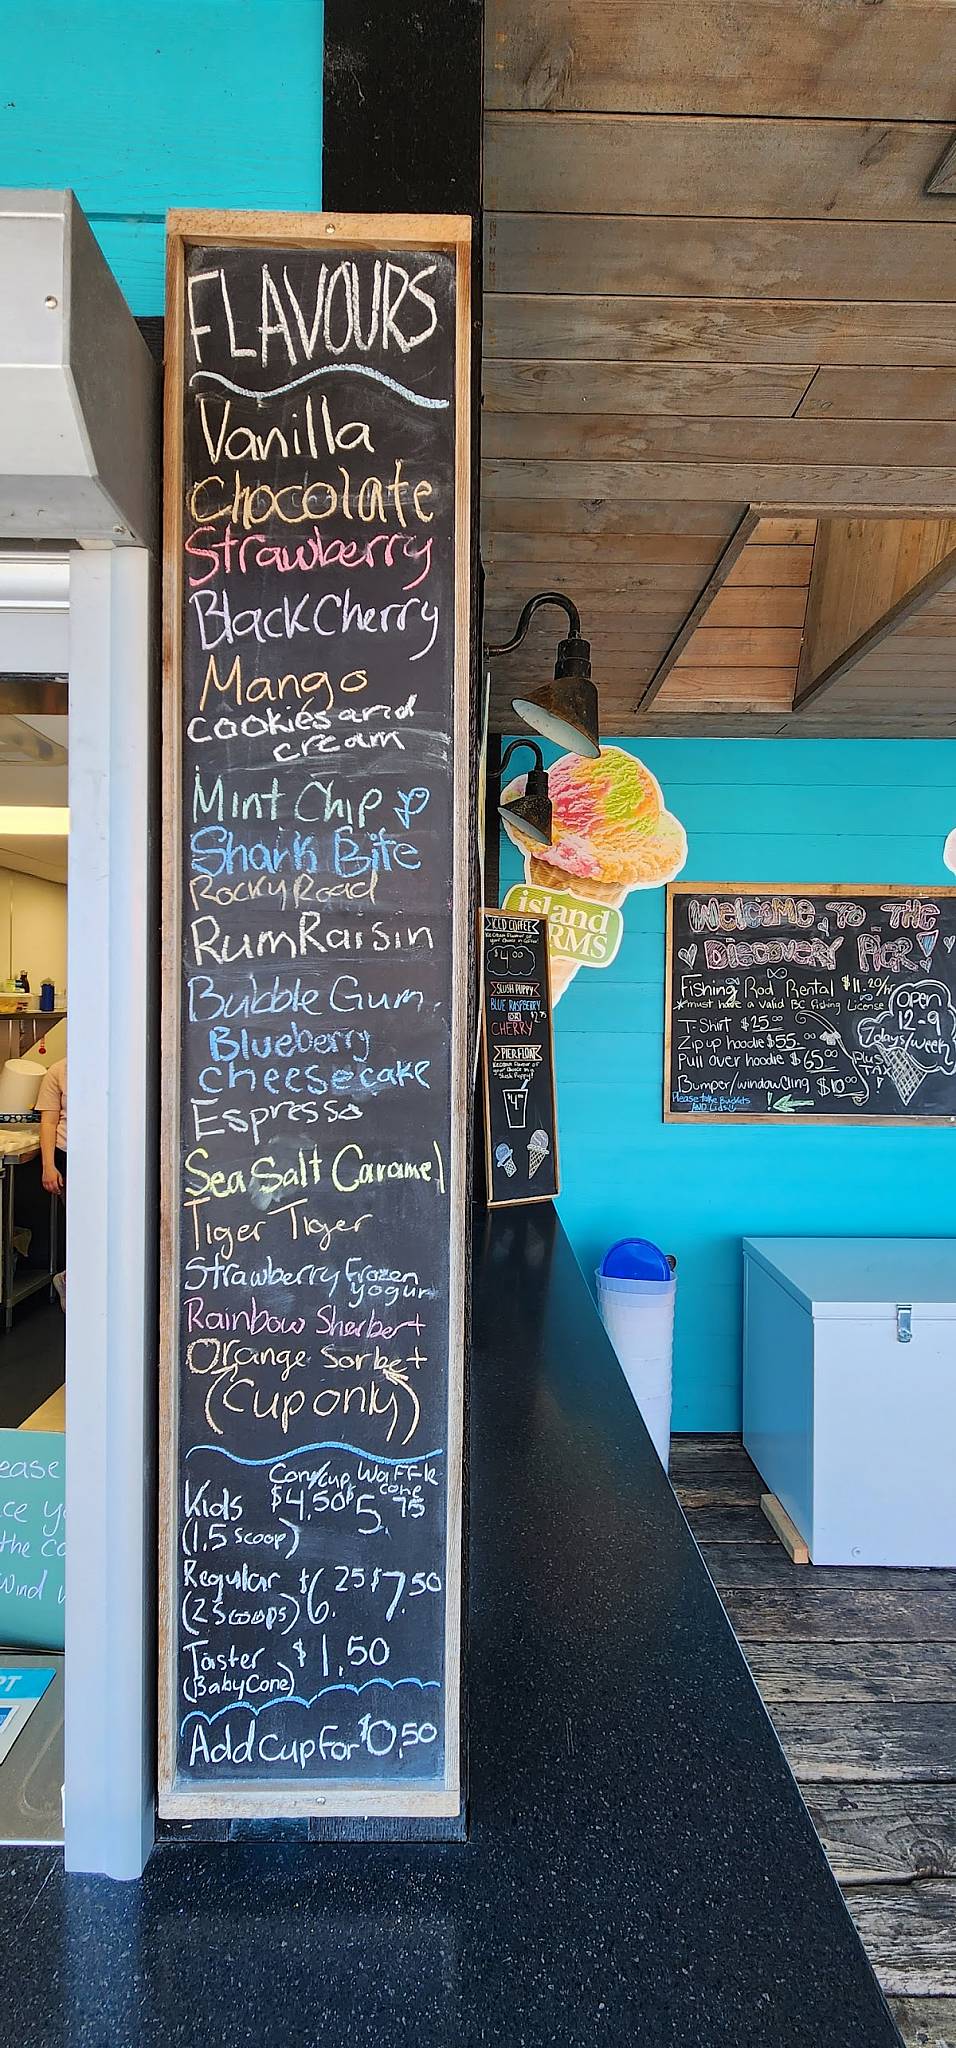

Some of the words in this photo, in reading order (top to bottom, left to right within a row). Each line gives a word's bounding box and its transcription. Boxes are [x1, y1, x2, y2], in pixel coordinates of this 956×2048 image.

[188, 259, 438, 368] FLAVOURS
[200, 394, 375, 465] Vanilla
[189, 459, 434, 529] Chocolate
[184, 524, 434, 590] Strawberry
[200, 654, 369, 711] Mango
[338, 693, 418, 722] and
[272, 729, 406, 763] cream
[193, 772, 286, 823] Mint
[295, 778, 383, 828] Chip
[190, 825, 318, 877] Shark
[334, 823, 422, 878] Bite
[188, 874, 286, 911] Rocky
[292, 870, 379, 908] Road
[508, 919, 532, 932] COFFEE
[518, 890, 610, 934] island
[549, 925, 608, 959] RMS
[187, 975, 323, 1022] Bubble
[490, 997, 507, 1012] BLUE
[508, 999, 541, 1012] RASPBERRY
[496, 983, 515, 995] SLUSH
[515, 984, 534, 996] PUPPY
[681, 974, 738, 1004] Fishing
[744, 976, 774, 999] Rod
[786, 979, 834, 999] Rental
[718, 1000, 742, 1010] have
[791, 1000, 806, 1010] BC
[847, 999, 885, 1011] License
[208, 1021, 371, 1063] Blueberry
[491, 1021, 533, 1036] CHERRY
[677, 1035, 704, 1053] Zip
[706, 1038, 722, 1053] up
[726, 1035, 765, 1049] hoodie
[678, 1053, 703, 1071] Pull
[709, 1054, 741, 1068] over
[745, 1052, 785, 1068] hoodie
[190, 1097, 364, 1145] Espresso
[184, 1147, 247, 1198] Sea
[249, 1144, 323, 1194] Salt
[331, 1140, 446, 1194] Caramel
[183, 1197, 268, 1260] Tiger
[266, 1198, 374, 1251] Tiger
[184, 1255, 341, 1298] Strawberry
[345, 1257, 419, 1285] Frozen
[184, 1297, 306, 1336] Rainbow
[185, 1337, 308, 1381] Orange
[320, 1346, 428, 1373] Sorbet
[0, 1460, 61, 1479] ease
[184, 1479, 243, 1520] Kids
[379, 1483, 423, 1499] cone
[183, 1559, 281, 1601] Regular
[182, 1640, 266, 1677] Taster
[189, 1720, 255, 1767] Add
